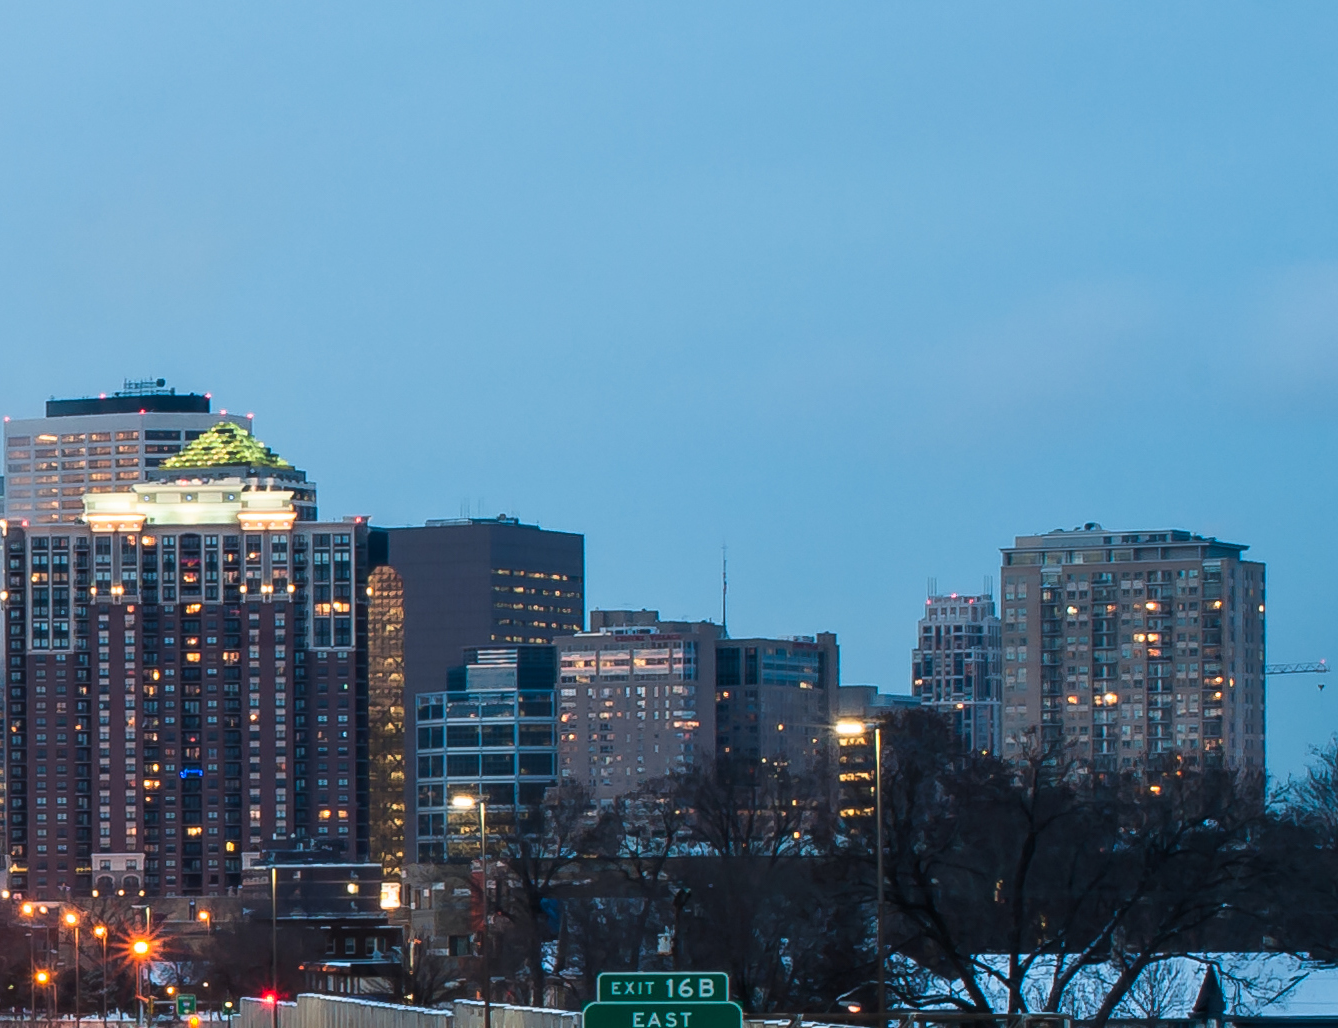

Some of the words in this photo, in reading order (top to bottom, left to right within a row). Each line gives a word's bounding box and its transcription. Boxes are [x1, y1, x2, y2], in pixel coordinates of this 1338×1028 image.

[611, 981, 655, 995] EXIT
[666, 978, 715, 998] 16B
[632, 1012, 692, 1028] EAST
